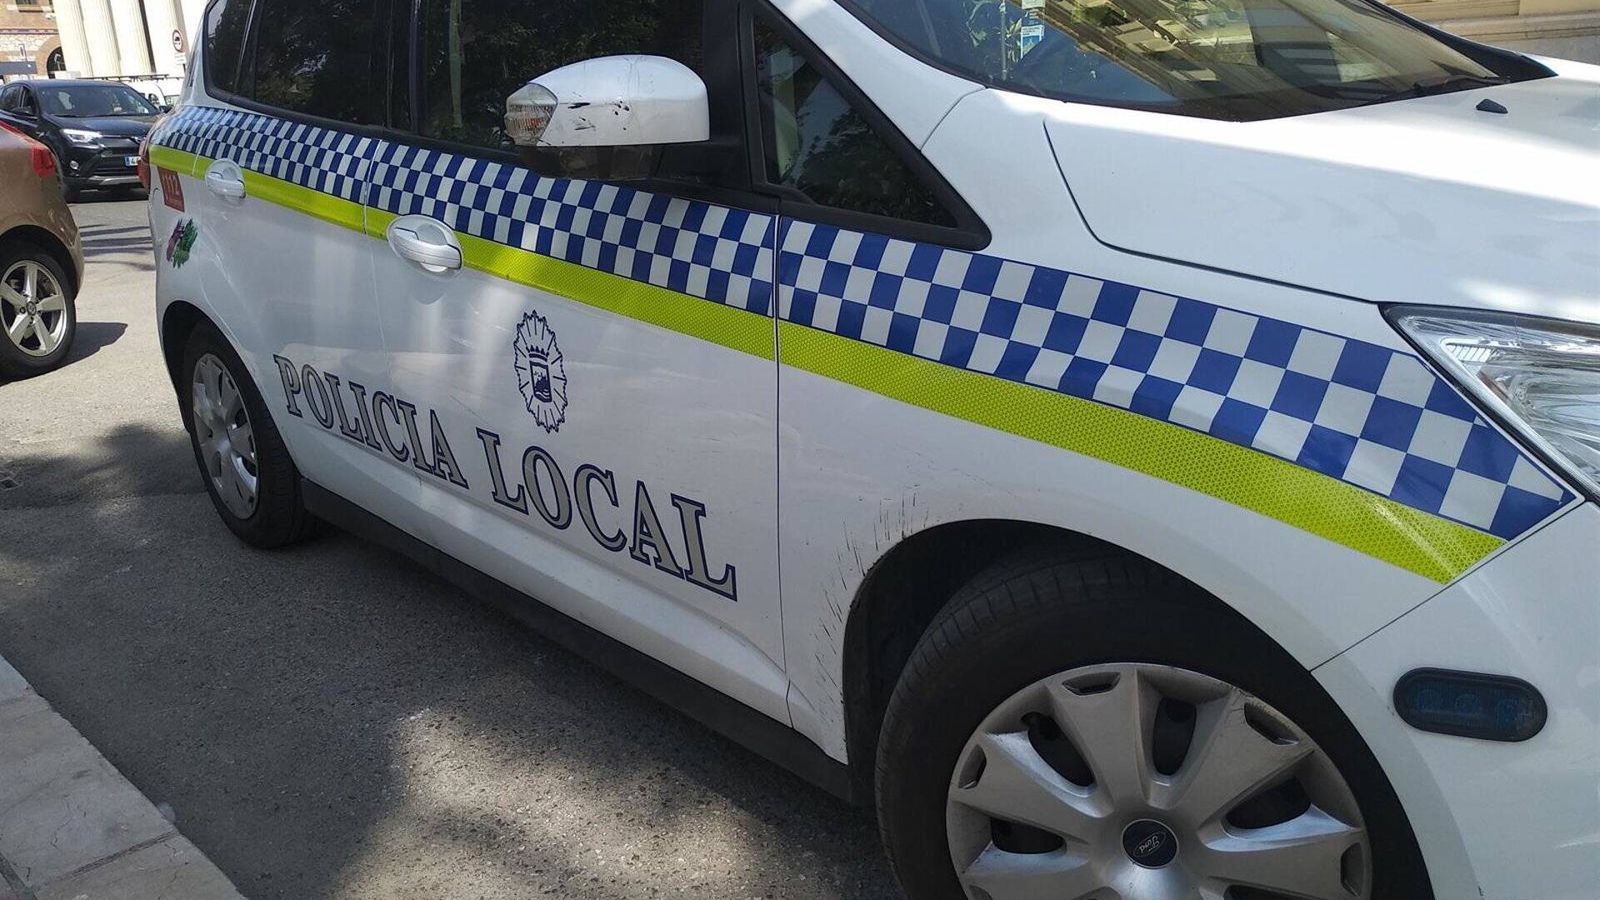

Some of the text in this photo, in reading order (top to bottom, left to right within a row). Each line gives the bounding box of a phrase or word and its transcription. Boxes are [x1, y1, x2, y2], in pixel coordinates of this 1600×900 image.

[273, 354, 738, 602] POLICIA LOCAL
[1138, 835, 1160, 854] Ford
